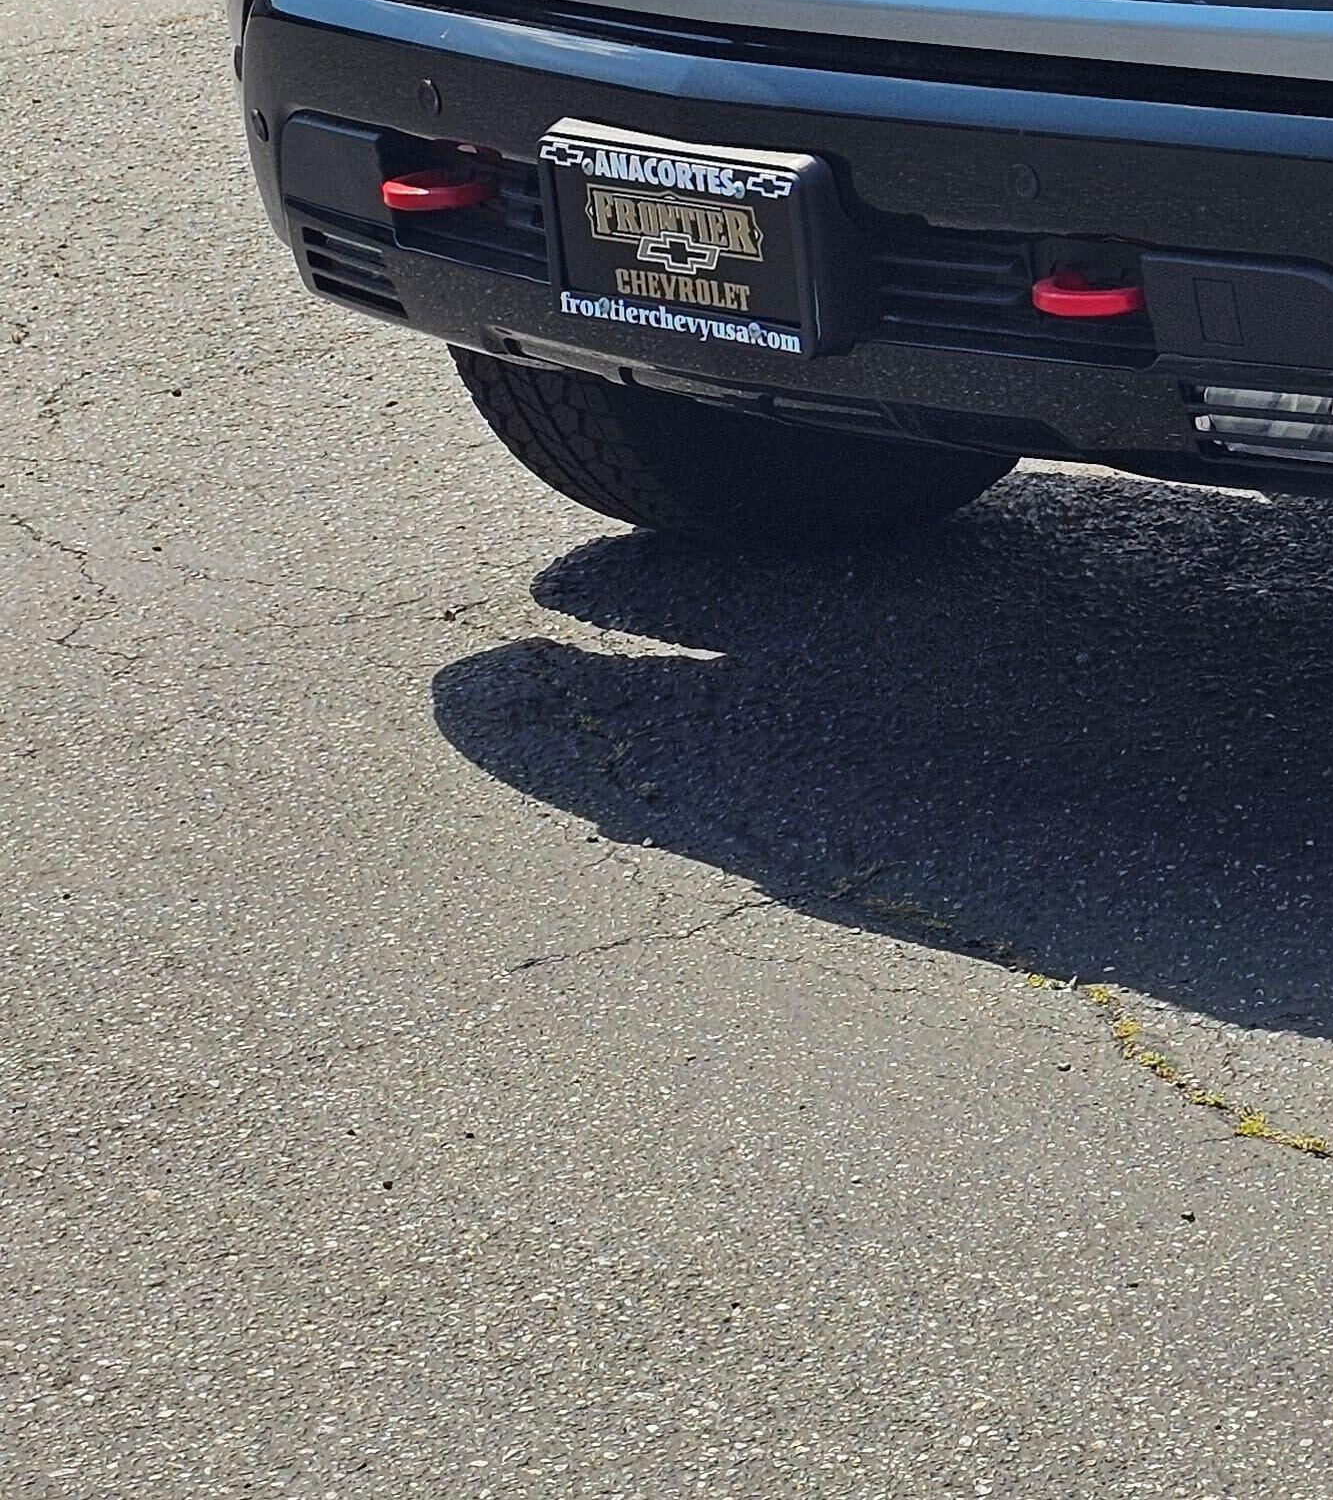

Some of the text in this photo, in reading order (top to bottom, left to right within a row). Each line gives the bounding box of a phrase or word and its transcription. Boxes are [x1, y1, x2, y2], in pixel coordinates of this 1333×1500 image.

[594, 149, 736, 197] ANACORTES
[592, 189, 758, 254] FRONTIER
[614, 267, 751, 312] CHEVROLET
[560, 291, 802, 354] frontierchevyusa.com
